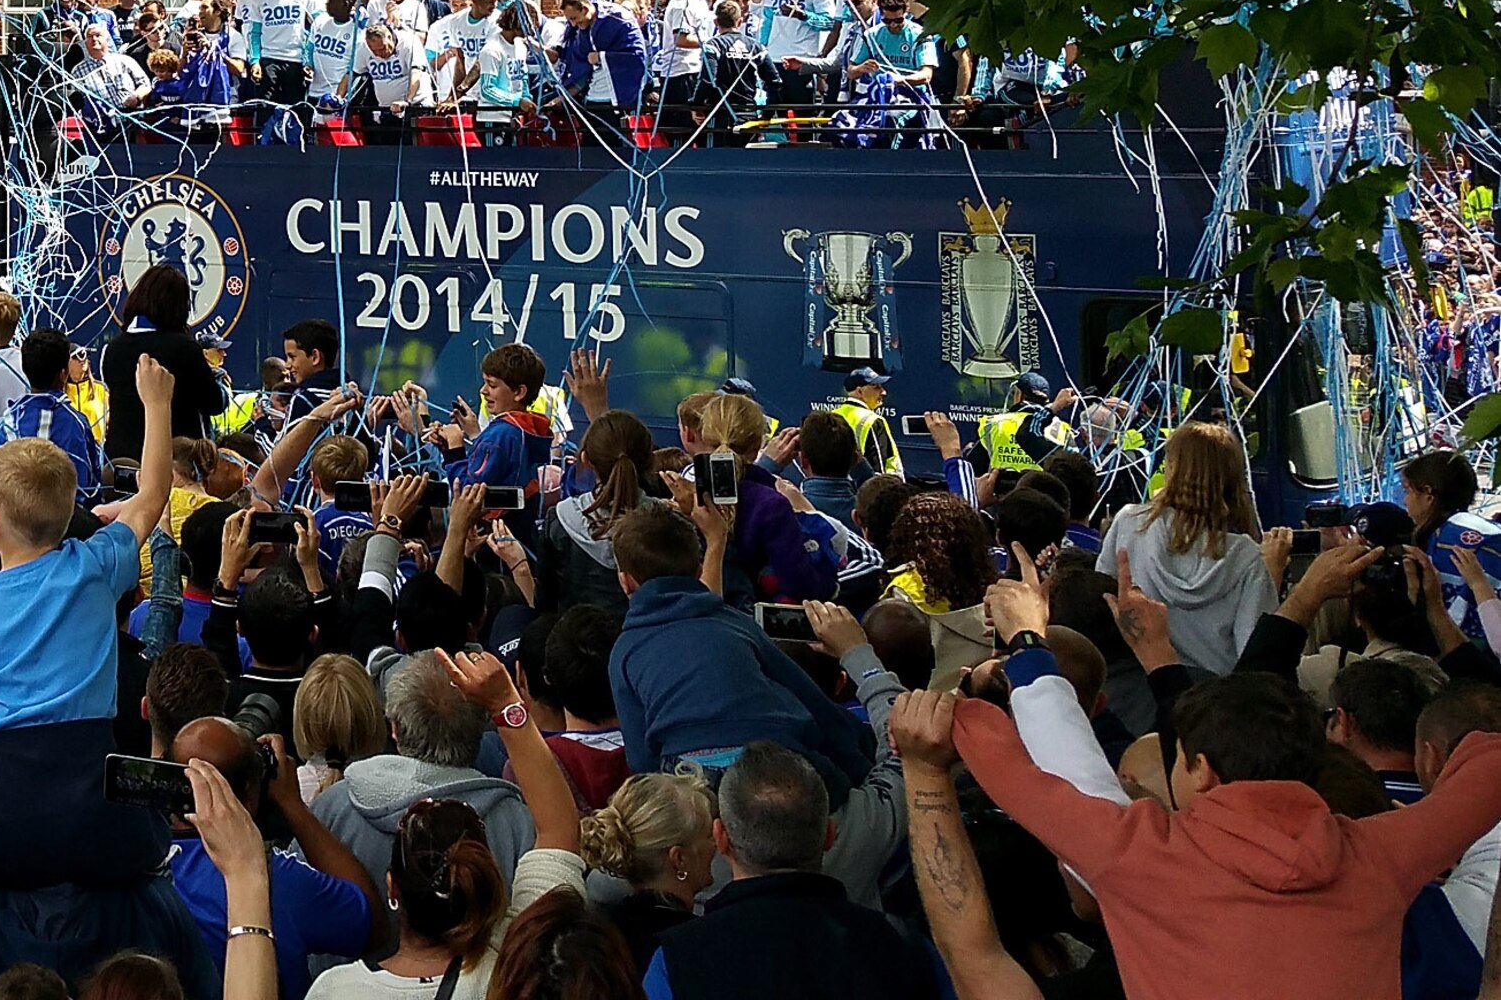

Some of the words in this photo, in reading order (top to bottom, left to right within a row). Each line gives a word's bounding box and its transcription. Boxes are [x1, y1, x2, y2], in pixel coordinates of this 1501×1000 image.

[263, 6, 300, 21] 2015
[314, 34, 346, 54] 2015
[370, 60, 402, 76] 2015
[429, 171, 539, 189] #ALLTHEWAY
[122, 181, 217, 220] CHELSEA
[285, 198, 706, 269] CHAMPIONS
[355, 272, 627, 343] 2014/15
[826, 395, 848, 403] CAPITA
[997, 446, 1025, 456] SAFE
[998, 454, 1035, 465] STEWAR
